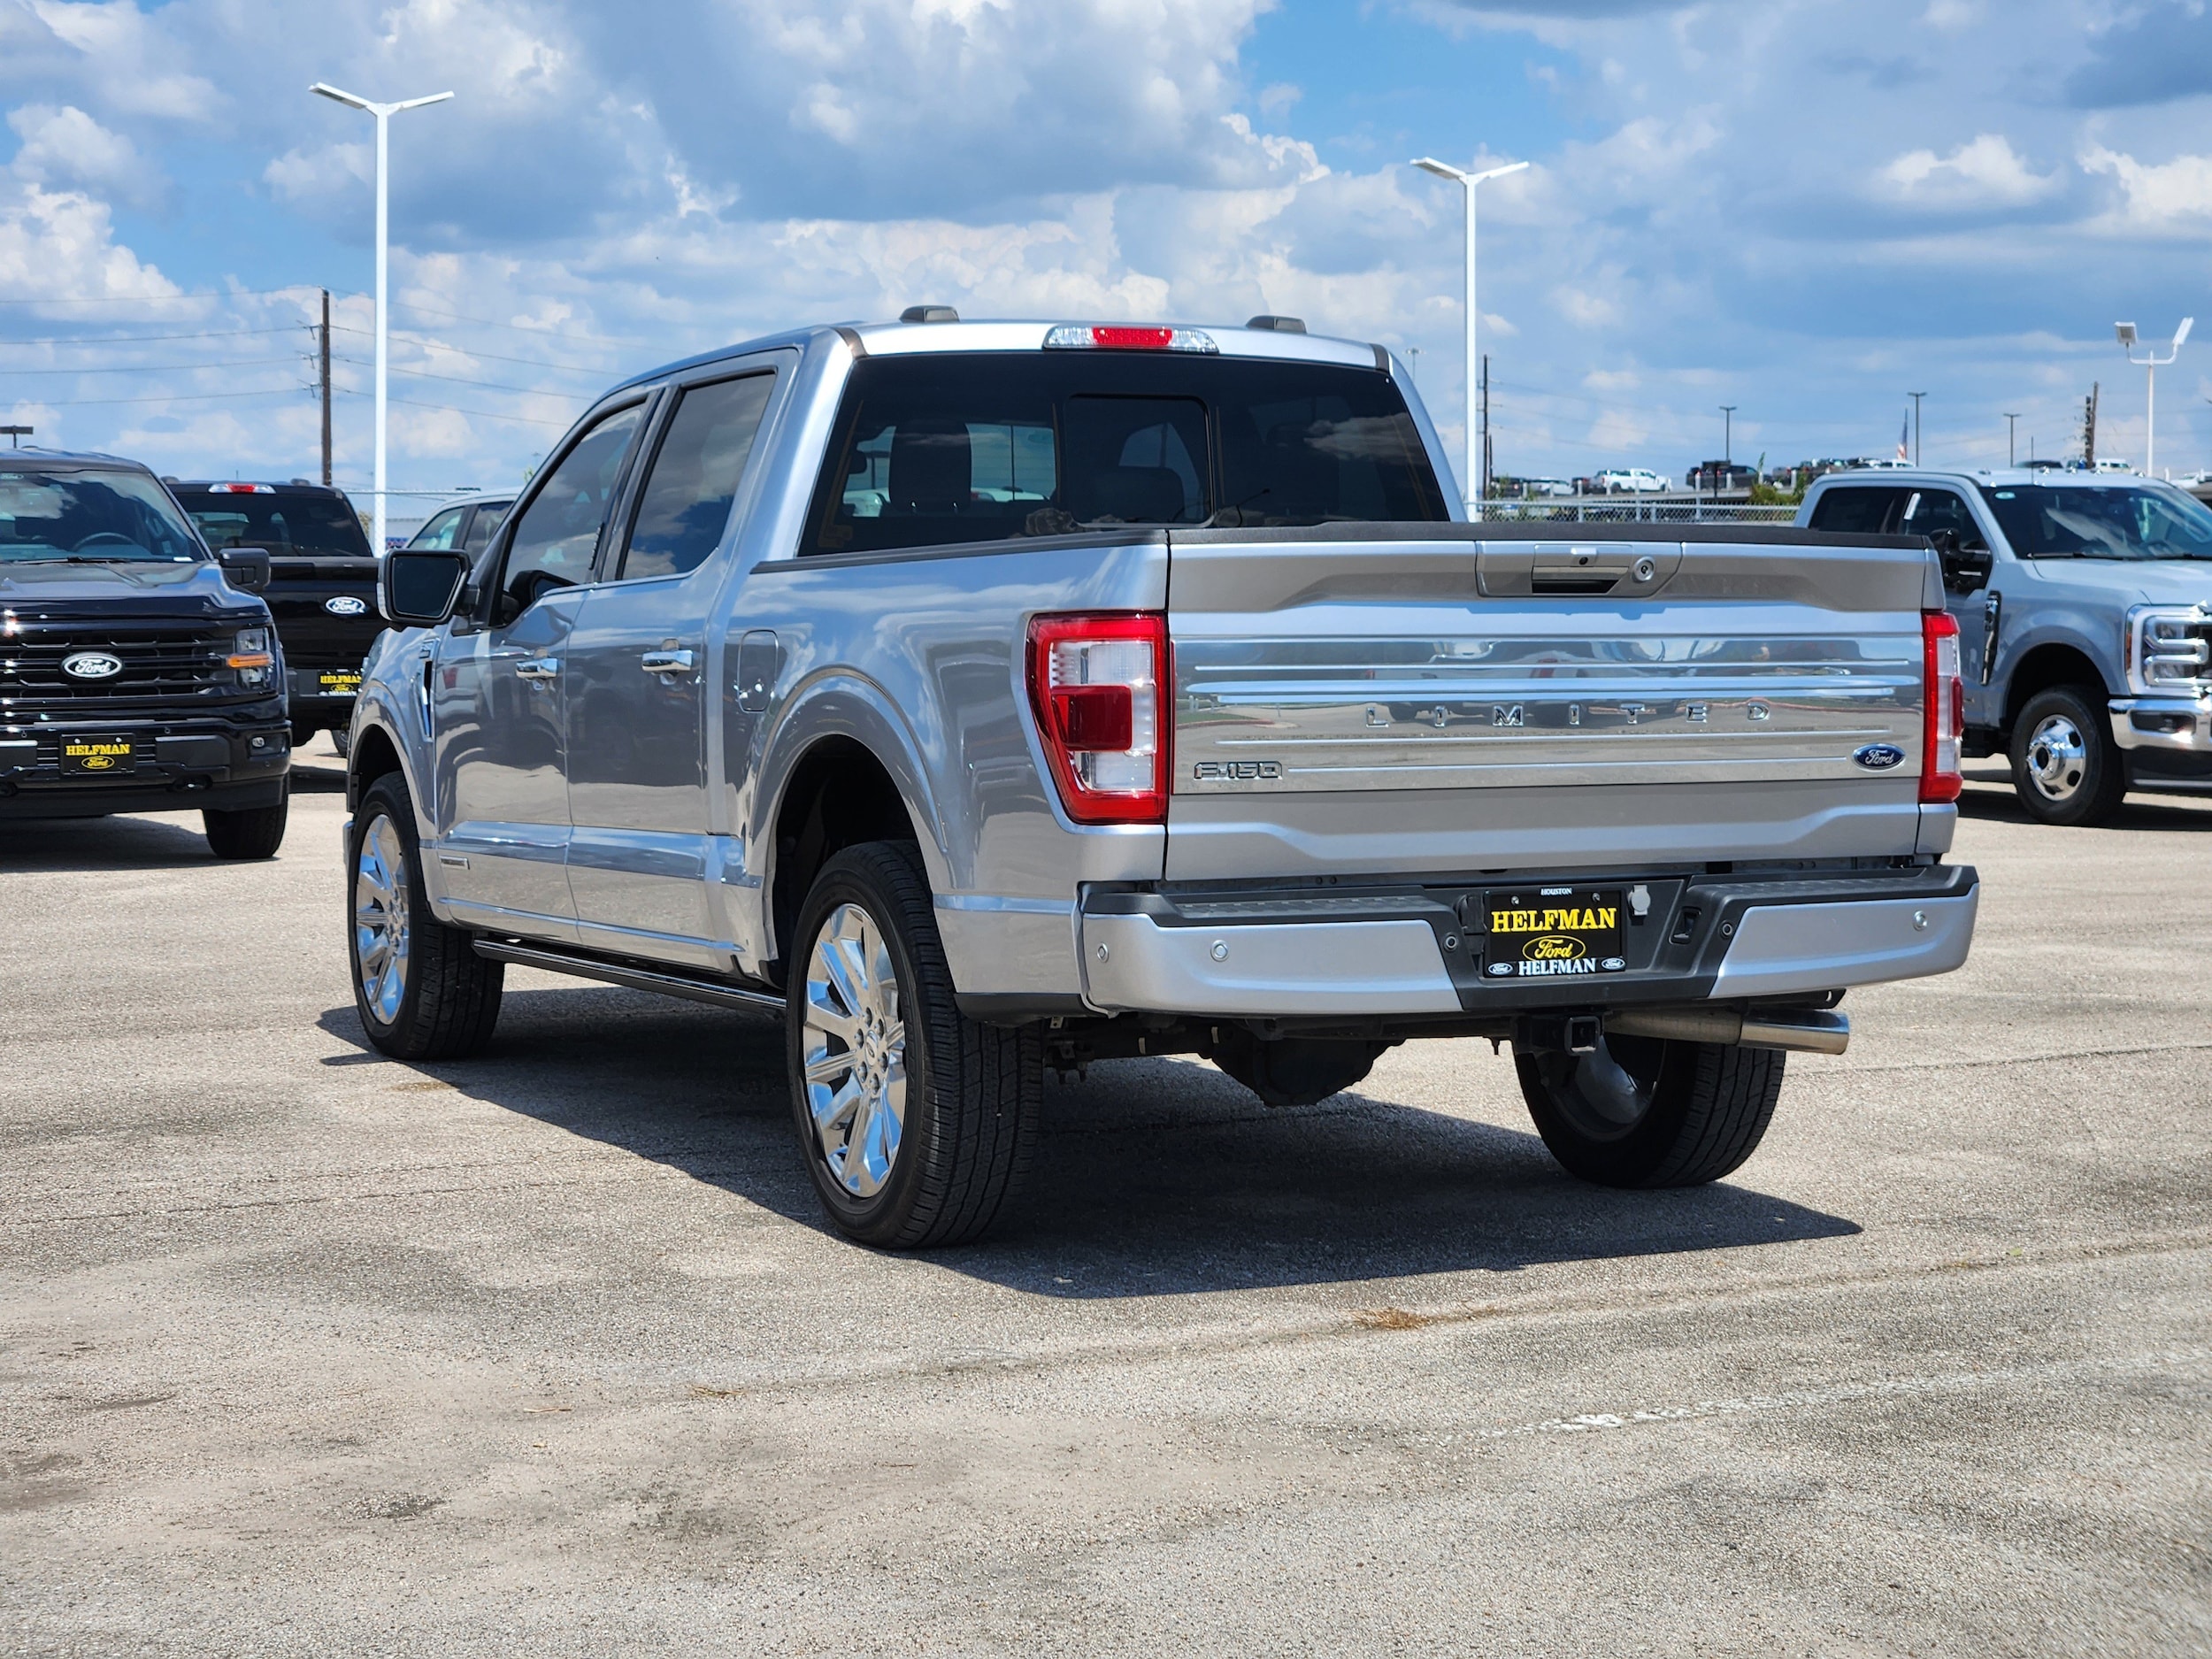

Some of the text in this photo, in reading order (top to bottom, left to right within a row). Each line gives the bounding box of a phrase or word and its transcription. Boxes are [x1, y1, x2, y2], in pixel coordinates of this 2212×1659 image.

[74, 658, 111, 673] Ford
[1365, 702, 1770, 728] LIMITED
[65, 744, 130, 756] HELFMAN
[1864, 747, 1895, 766] Ford
[87, 757, 109, 767] Ford
[1194, 760, 1284, 781] F-150
[1491, 907, 1617, 933] HELFMAN
[1533, 938, 1574, 959] Ford
[1518, 958, 1597, 976] HELFMAN
